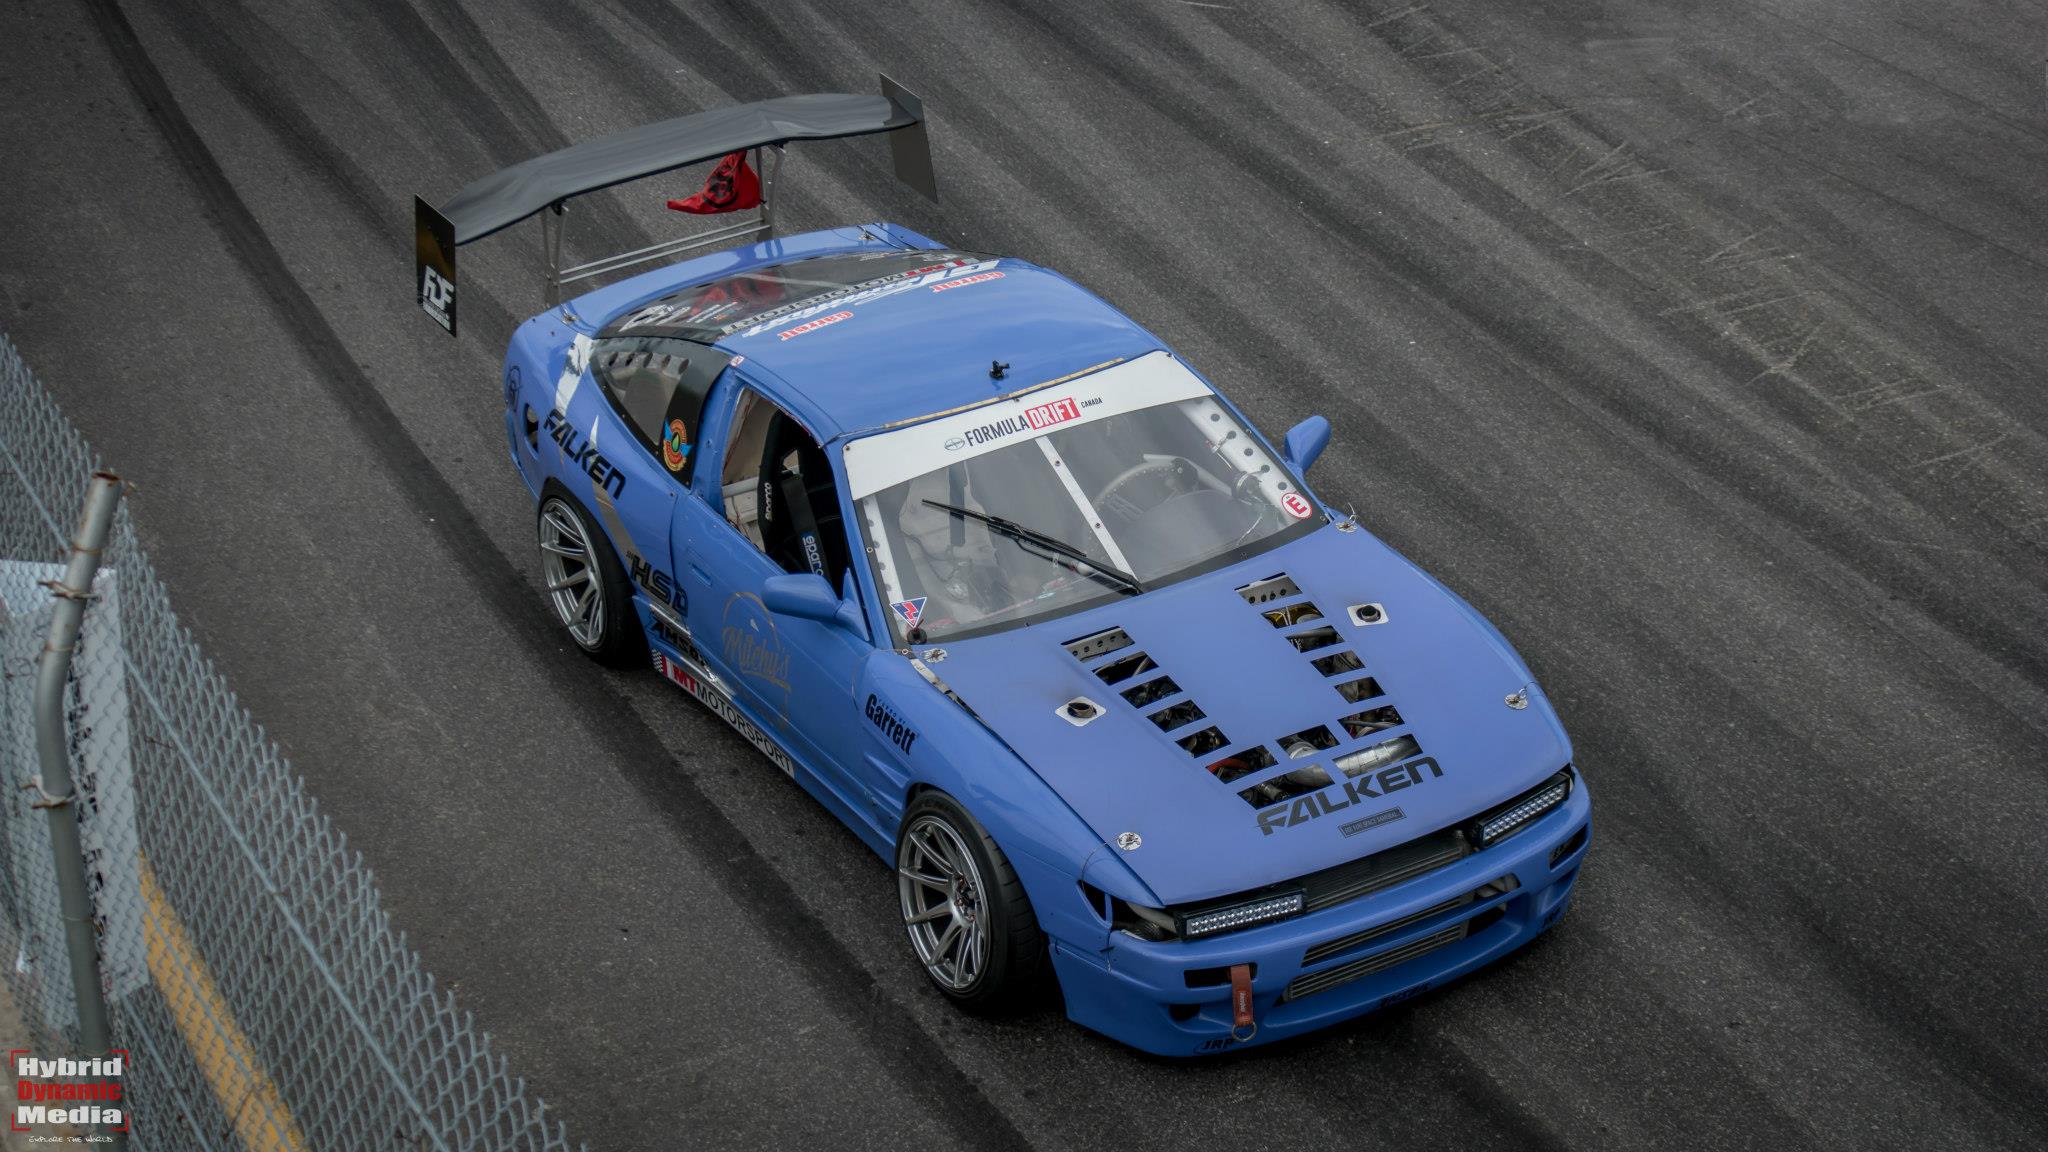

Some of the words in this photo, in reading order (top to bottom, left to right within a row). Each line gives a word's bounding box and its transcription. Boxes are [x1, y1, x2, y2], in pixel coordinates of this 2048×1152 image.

[543, 408, 626, 501] FALKEN
[964, 414, 1030, 447] FORMULA
[1026, 398, 1079, 429] DRIFT
[1080, 397, 1103, 409] CANADA
[803, 535, 824, 576] sparc
[696, 682, 792, 773] MOTORSPORT
[865, 692, 918, 756] Garrett
[1256, 755, 1444, 836] FALKEN
